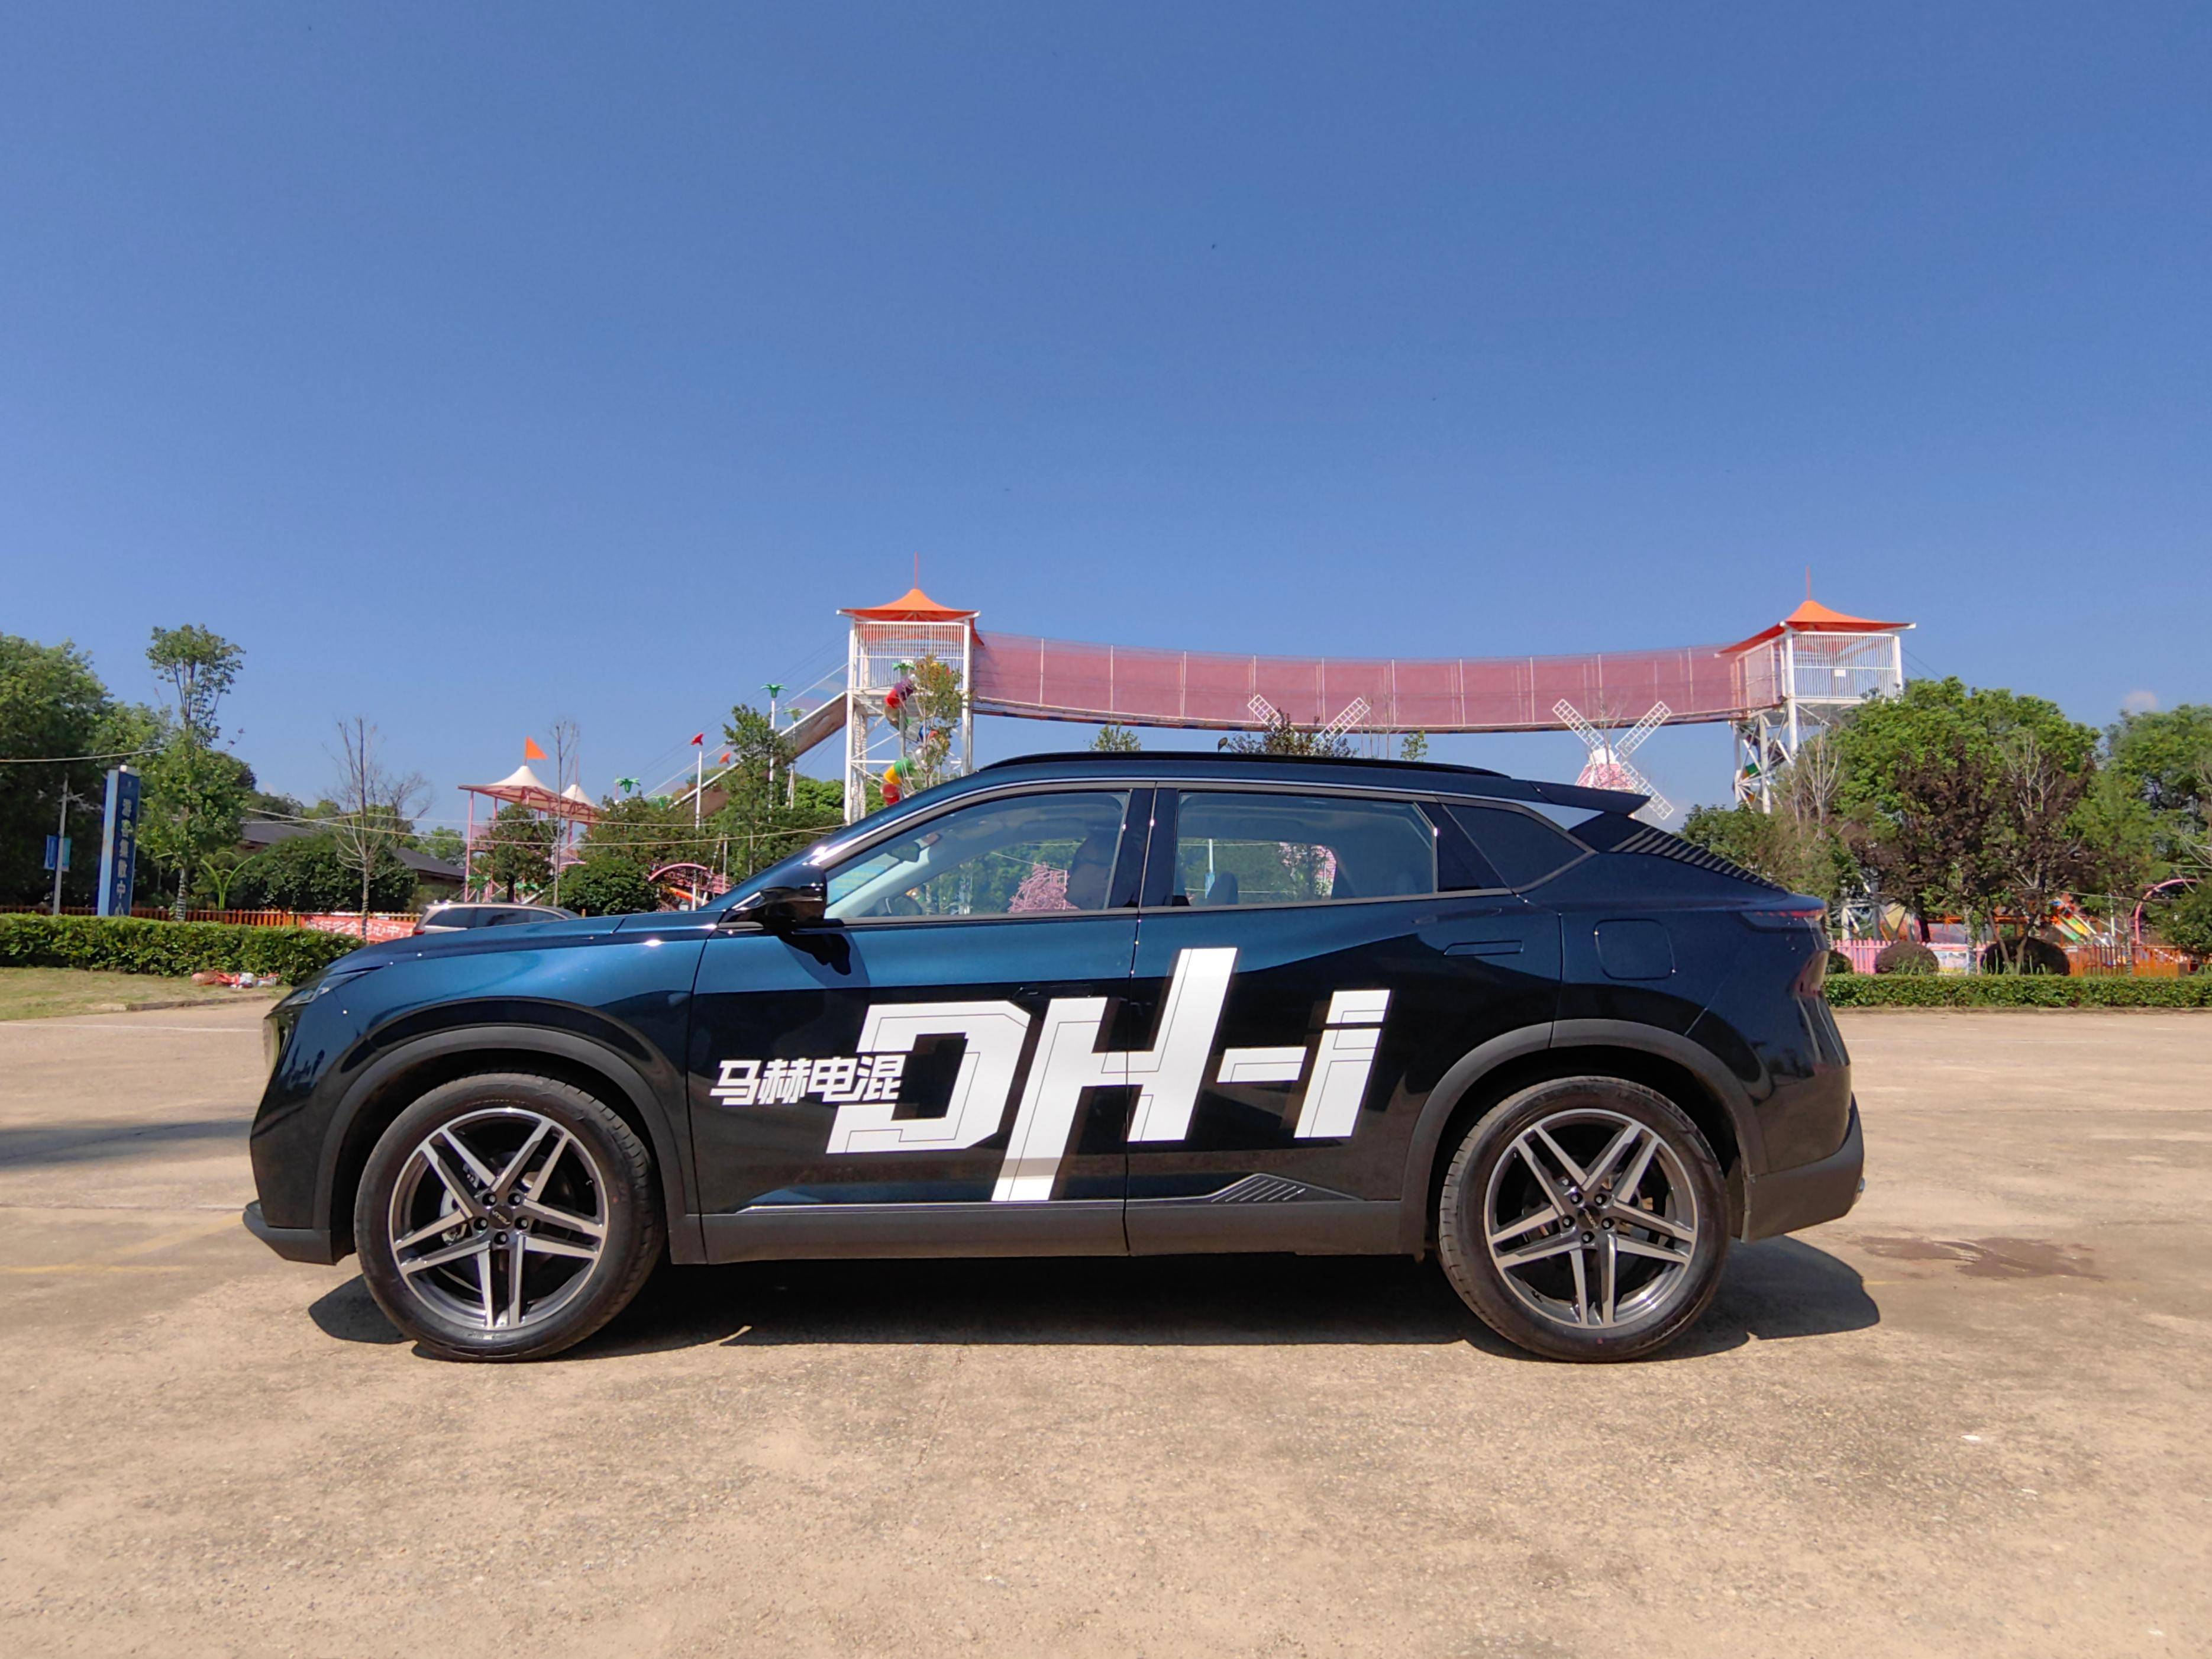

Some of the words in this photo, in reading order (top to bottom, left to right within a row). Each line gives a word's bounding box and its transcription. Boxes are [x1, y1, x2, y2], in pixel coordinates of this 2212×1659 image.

[709, 1055, 906, 1106] 马赫电混
[826, 947, 1391, 1202] DH-i
